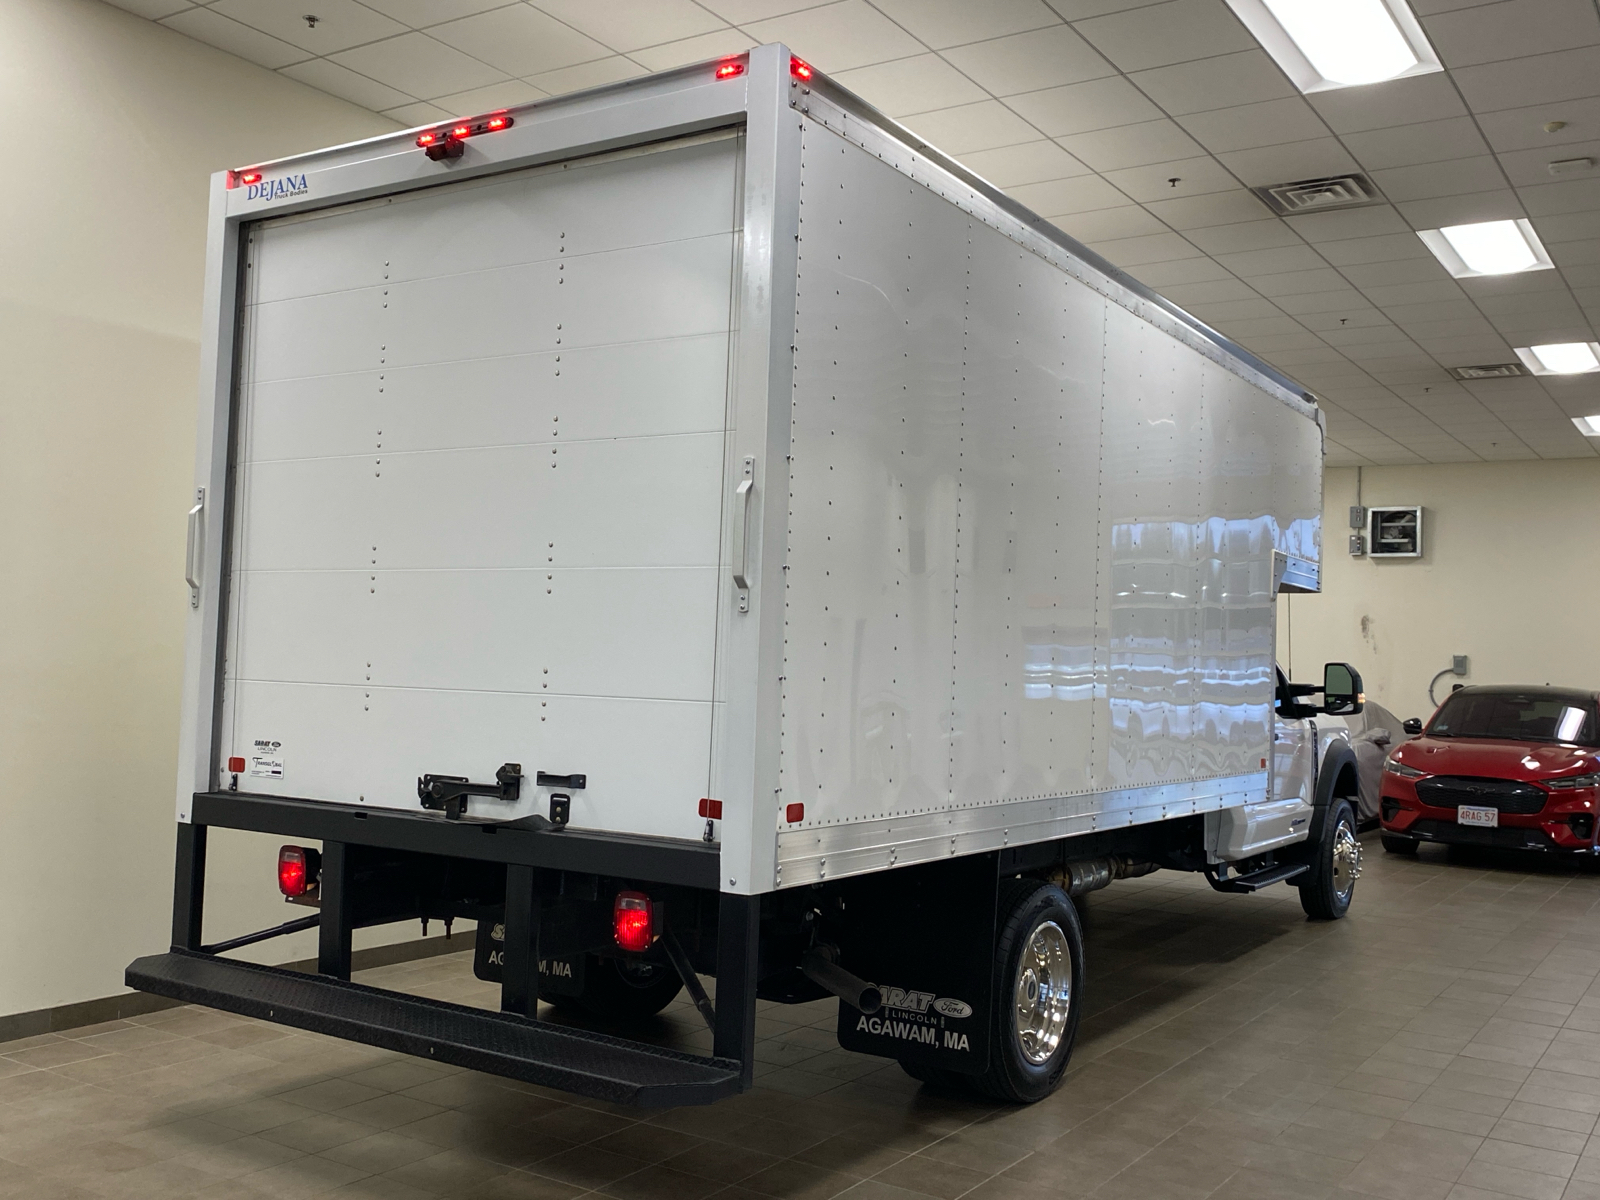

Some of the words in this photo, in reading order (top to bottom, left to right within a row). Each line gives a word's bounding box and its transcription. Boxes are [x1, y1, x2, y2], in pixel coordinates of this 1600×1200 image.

[247, 174, 308, 201] DEJANA
[289, 189, 308, 197] Bodies
[1460, 810, 1482, 821] 4RAG
[1484, 812, 1496, 822] 57
[552, 960, 572, 978] MA
[868, 982, 936, 1013] ARAT
[939, 1000, 968, 1017] Ford
[891, 1009, 938, 1025] LINCOLN
[856, 1015, 940, 1048] AGAWAM,
[943, 1030, 971, 1052] MA
